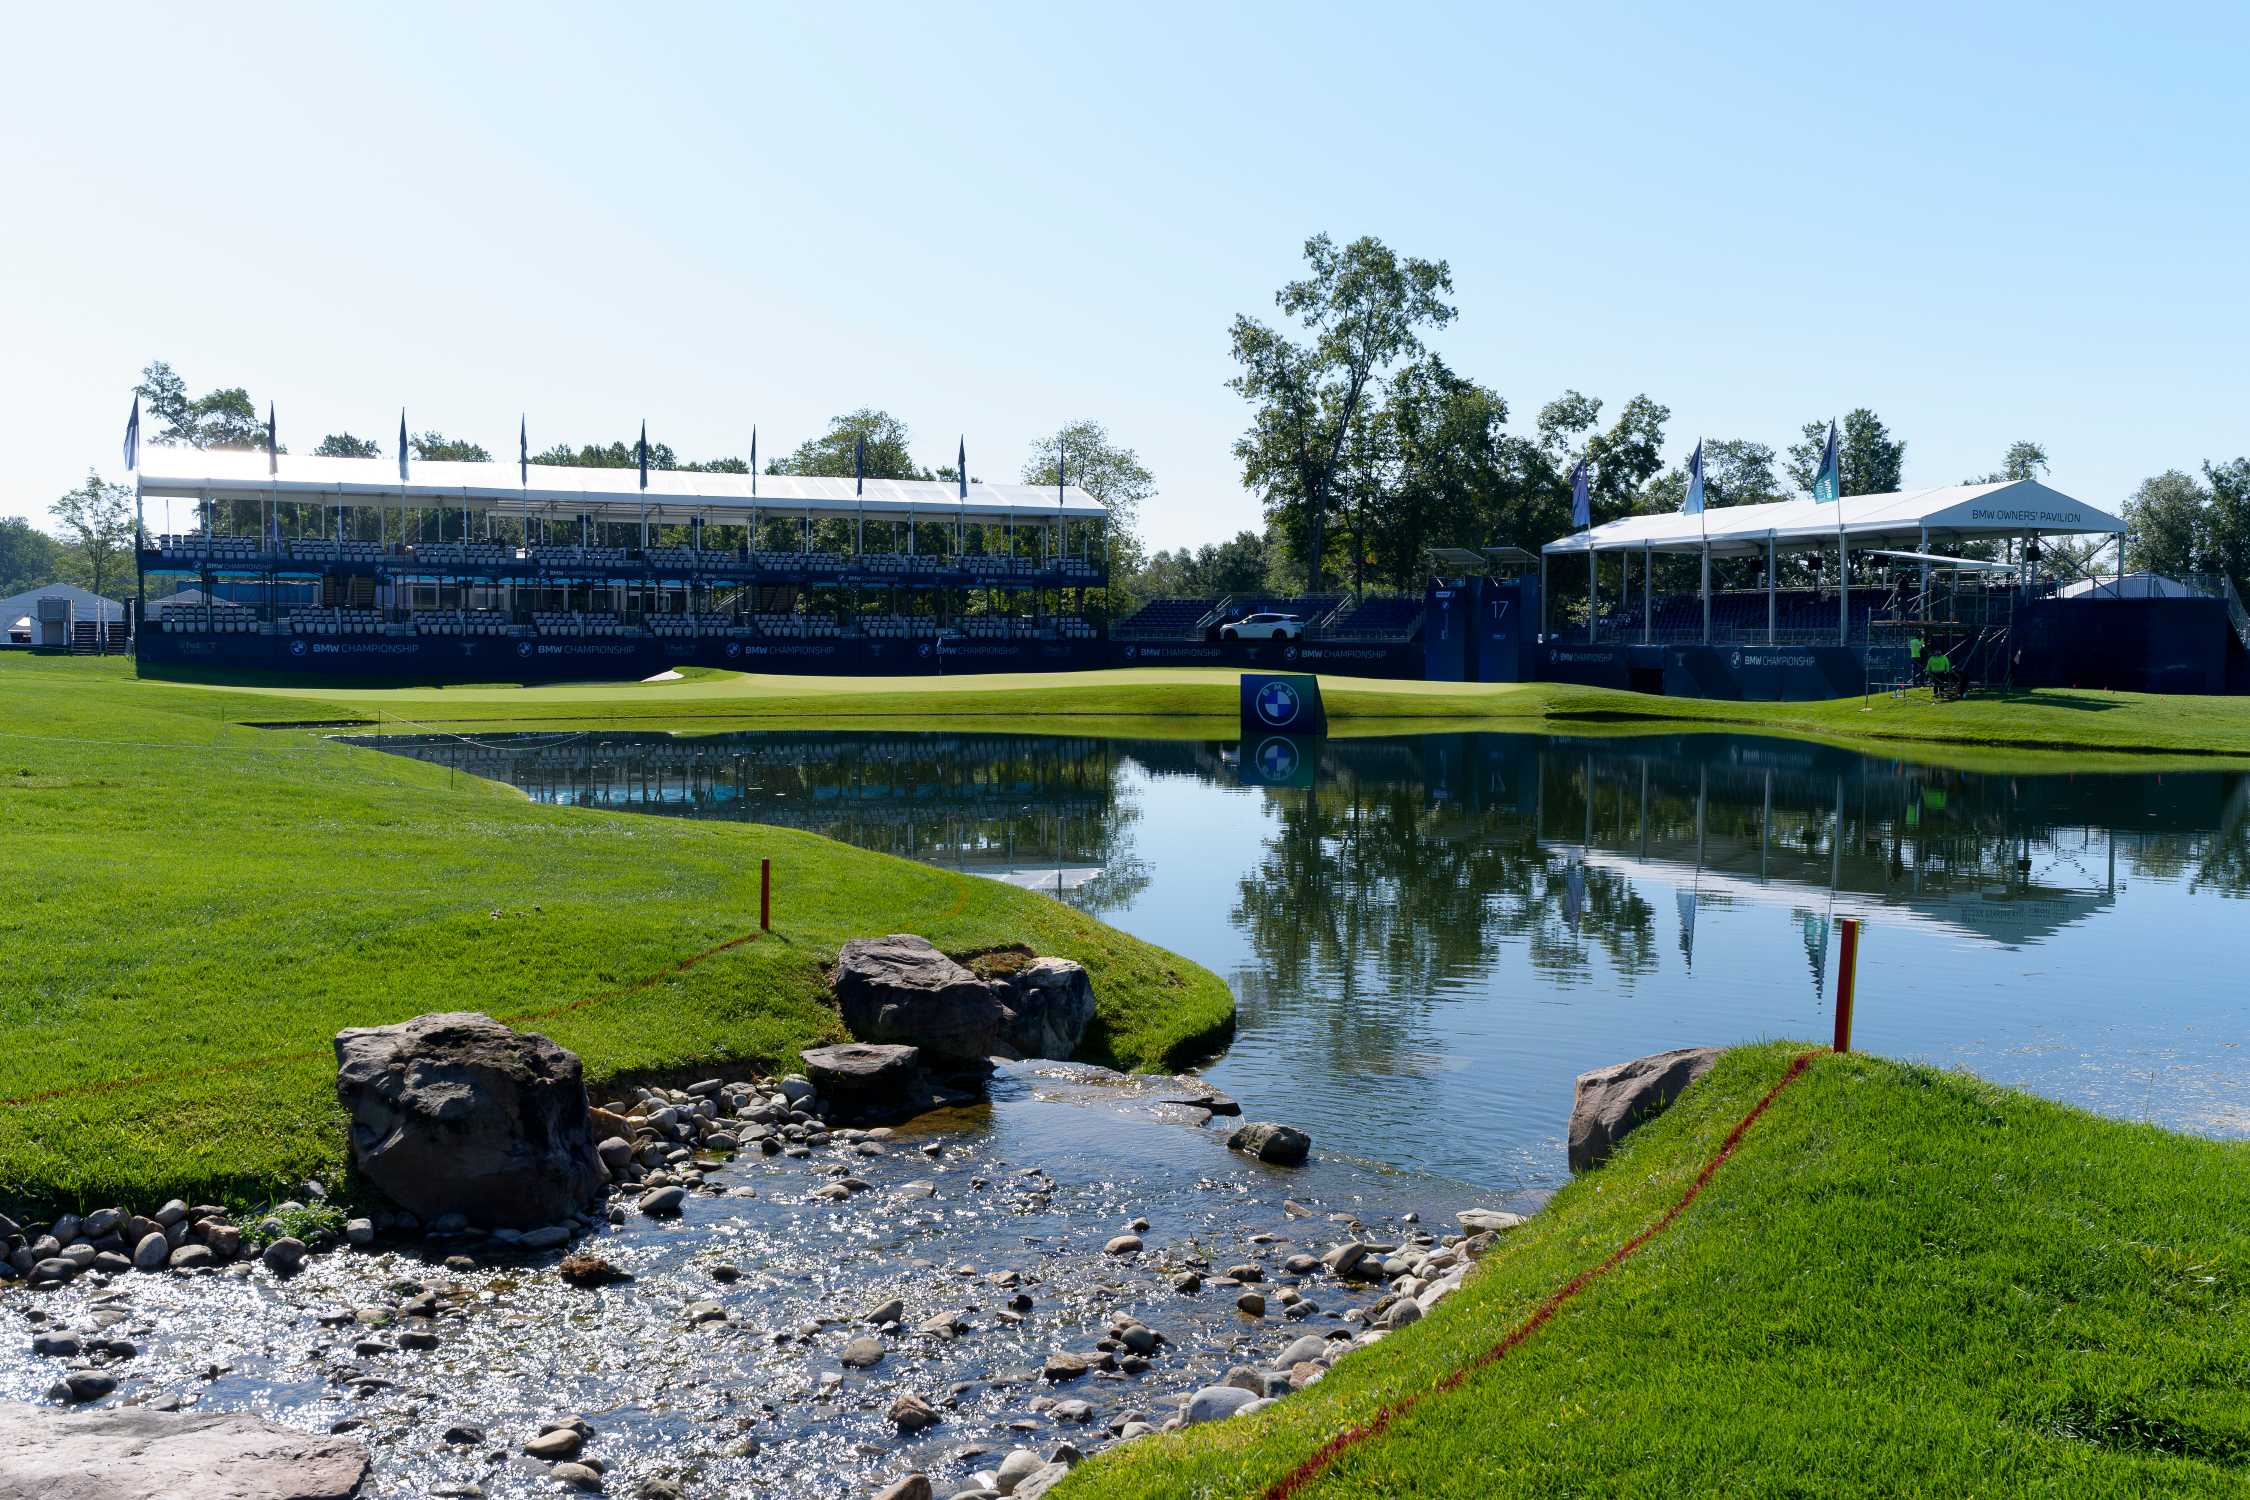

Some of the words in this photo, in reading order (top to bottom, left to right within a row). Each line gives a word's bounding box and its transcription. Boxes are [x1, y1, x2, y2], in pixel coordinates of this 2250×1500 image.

[1972, 509, 1995, 520] BMW
[1997, 510, 2038, 521] OWNERS'
[2040, 511, 2081, 523] PAVILION
[1490, 600, 1510, 620] 17
[312, 643, 340, 653] BMW
[341, 643, 420, 654] CHAMPIONSHIP
[538, 645, 563, 654] BMW
[564, 645, 636, 655] CHAMPIONSHIP
[745, 646, 768, 655] BMW
[769, 646, 834, 655] CHAMPIONSHIP
[958, 646, 1019, 656] CHAMPIONSHIP
[1139, 648, 1161, 657] BMW
[1161, 648, 1221, 657] CHAMPIONSHIP
[1301, 649, 1322, 658] BMW
[1323, 649, 1386, 659] CHAMPIONSHIP
[1744, 655, 1761, 665] BMW
[1762, 655, 1816, 667] CHAMPIONSHIP
